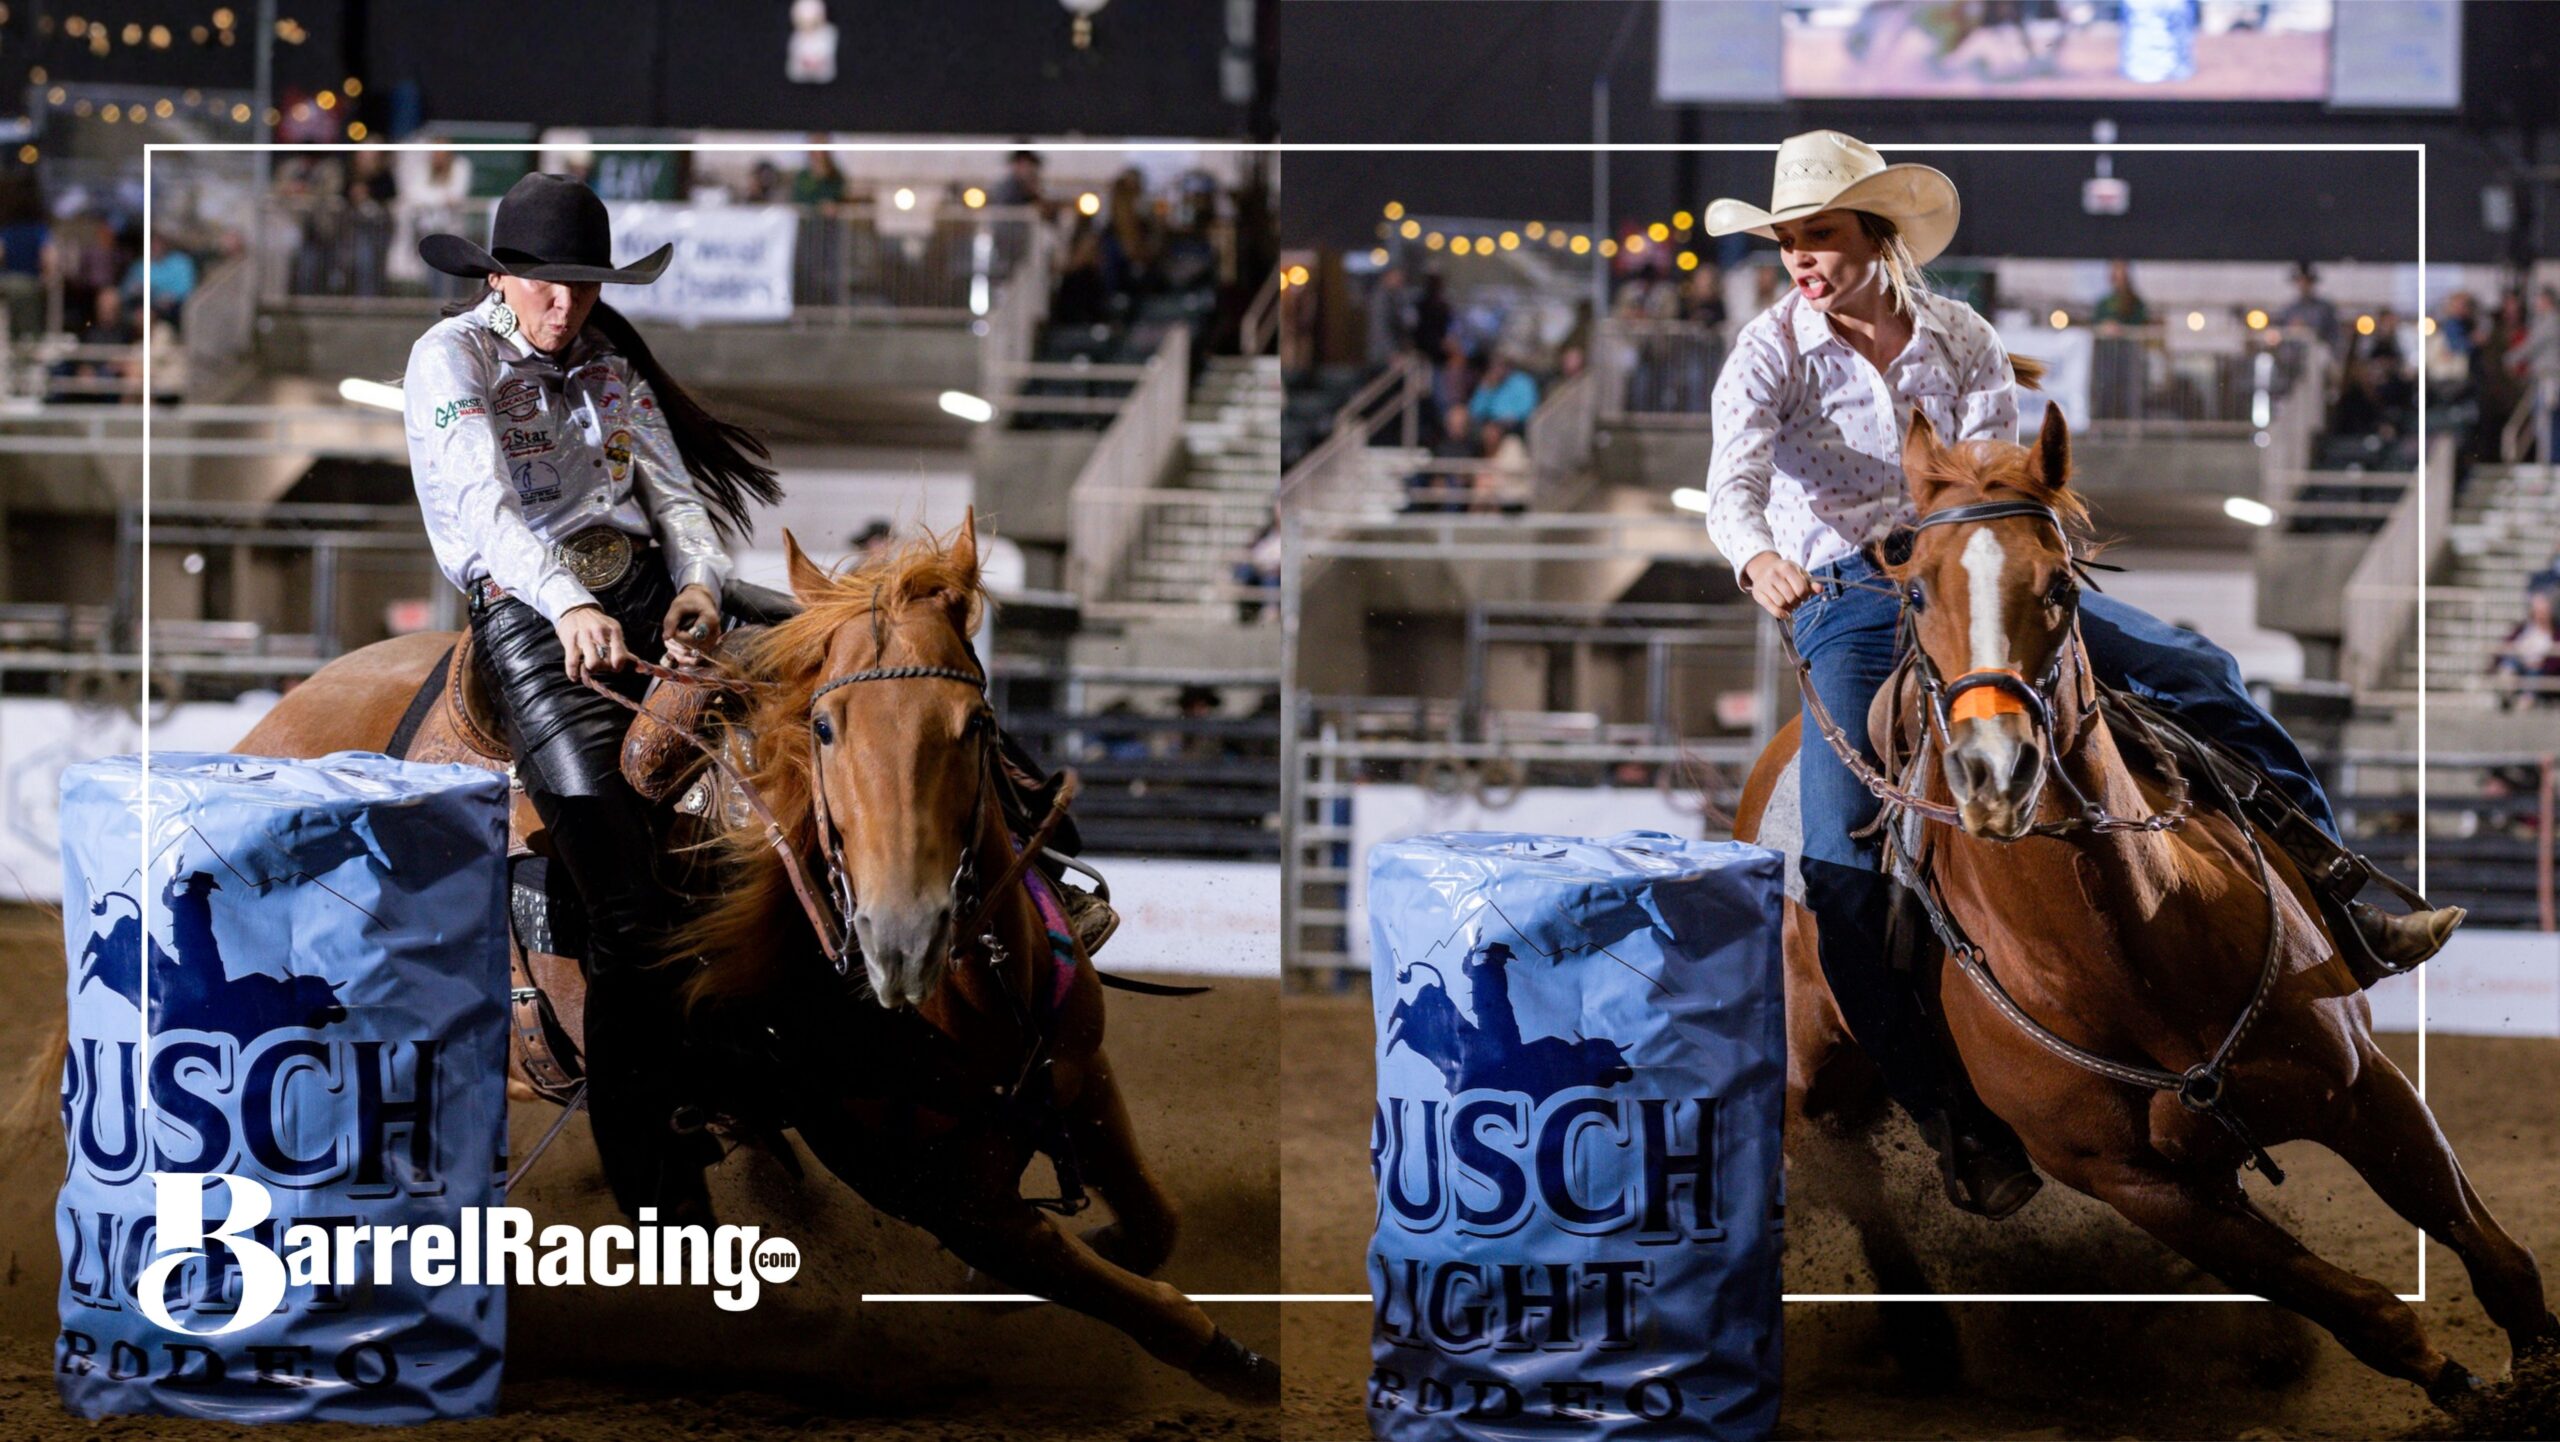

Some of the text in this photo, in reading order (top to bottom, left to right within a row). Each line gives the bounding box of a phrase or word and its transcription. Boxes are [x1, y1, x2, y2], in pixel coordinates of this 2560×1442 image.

[1375, 1254, 1655, 1354] LIGHT
[59, 1328, 399, 1390] RODEO
[1371, 1367, 1685, 1422] RODEO
